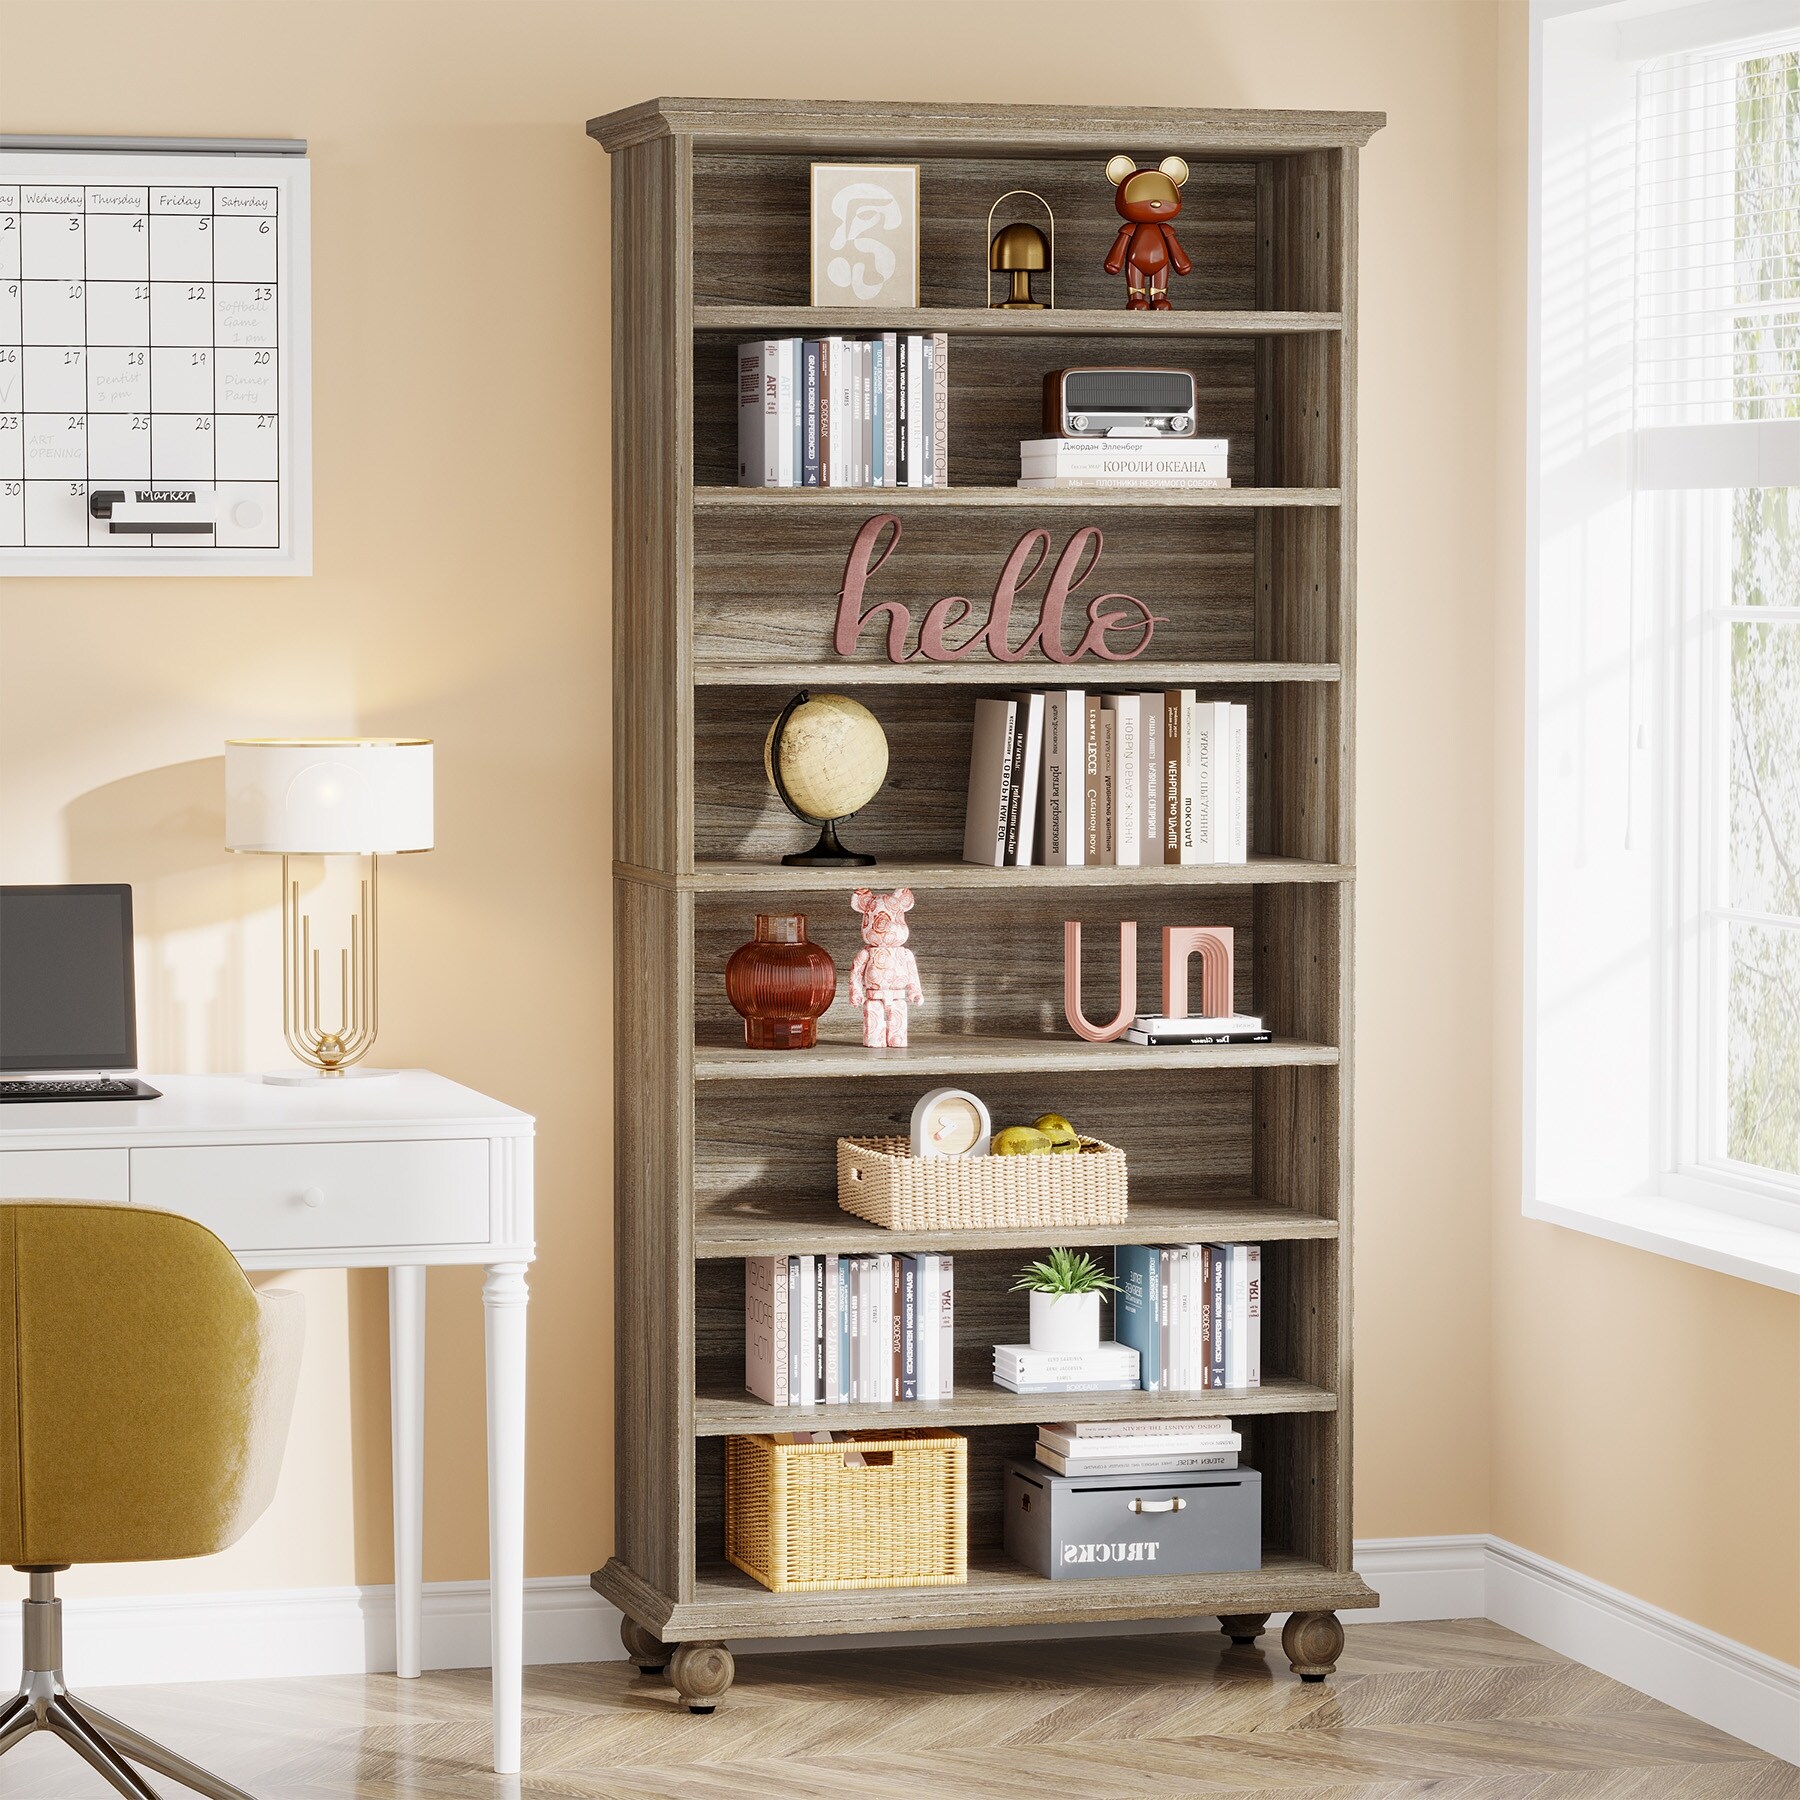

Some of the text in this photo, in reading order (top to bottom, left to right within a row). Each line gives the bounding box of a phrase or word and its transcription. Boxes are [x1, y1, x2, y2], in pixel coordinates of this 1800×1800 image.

[26, 194, 82, 206] Wednesday
[92, 194, 141, 206] Thursday
[160, 196, 201, 208] Friday
[222, 197, 268, 209] Saturday
[4, 218, 16, 230] 2
[69, 219, 79, 231] 3
[133, 220, 144, 232] 4
[199, 217, 210, 230] 5
[259, 221, 269, 233] 6
[9, 285, 17, 297] 9
[69, 286, 82, 299] 10
[135, 287, 150, 299] 11
[188, 287, 206, 300] 12
[254, 288, 272, 300] 13
[219, 300, 268, 314] Softball
[224, 316, 258, 328] Game
[233, 333, 266, 344] 1 pm
[0, 350, 16, 363] 16
[64, 352, 80, 365] 17
[128, 352, 144, 366] 18
[192, 353, 206, 366] 19
[254, 352, 270, 364] 20
[97, 372, 141, 386] Dentist
[225, 375, 269, 385] Dinner
[886, 370, 894, 400] BOOK
[767, 375, 776, 398] ART
[97, 391, 132, 402] 3 pm
[225, 390, 258, 403] Party
[935, 337, 946, 477] ALEXEY BRODOVITCH
[1, 417, 19, 430] 23
[68, 417, 85, 430] 24
[132, 417, 150, 430] 25
[195, 417, 211, 430] 26
[258, 416, 275, 428] 27
[30, 435, 55, 444] ART
[886, 412, 894, 466] SYMBOLS
[1063, 443, 1143, 451] Джордан Элленберг
[30, 448, 81, 459] OPENING
[1104, 461, 1206, 472] КОРОЛИ ОКЕАНА
[5, 484, 20, 496] 30
[70, 484, 86, 496] 31
[141, 491, 193, 501] Marker
[834, 514, 1170, 664] hello
